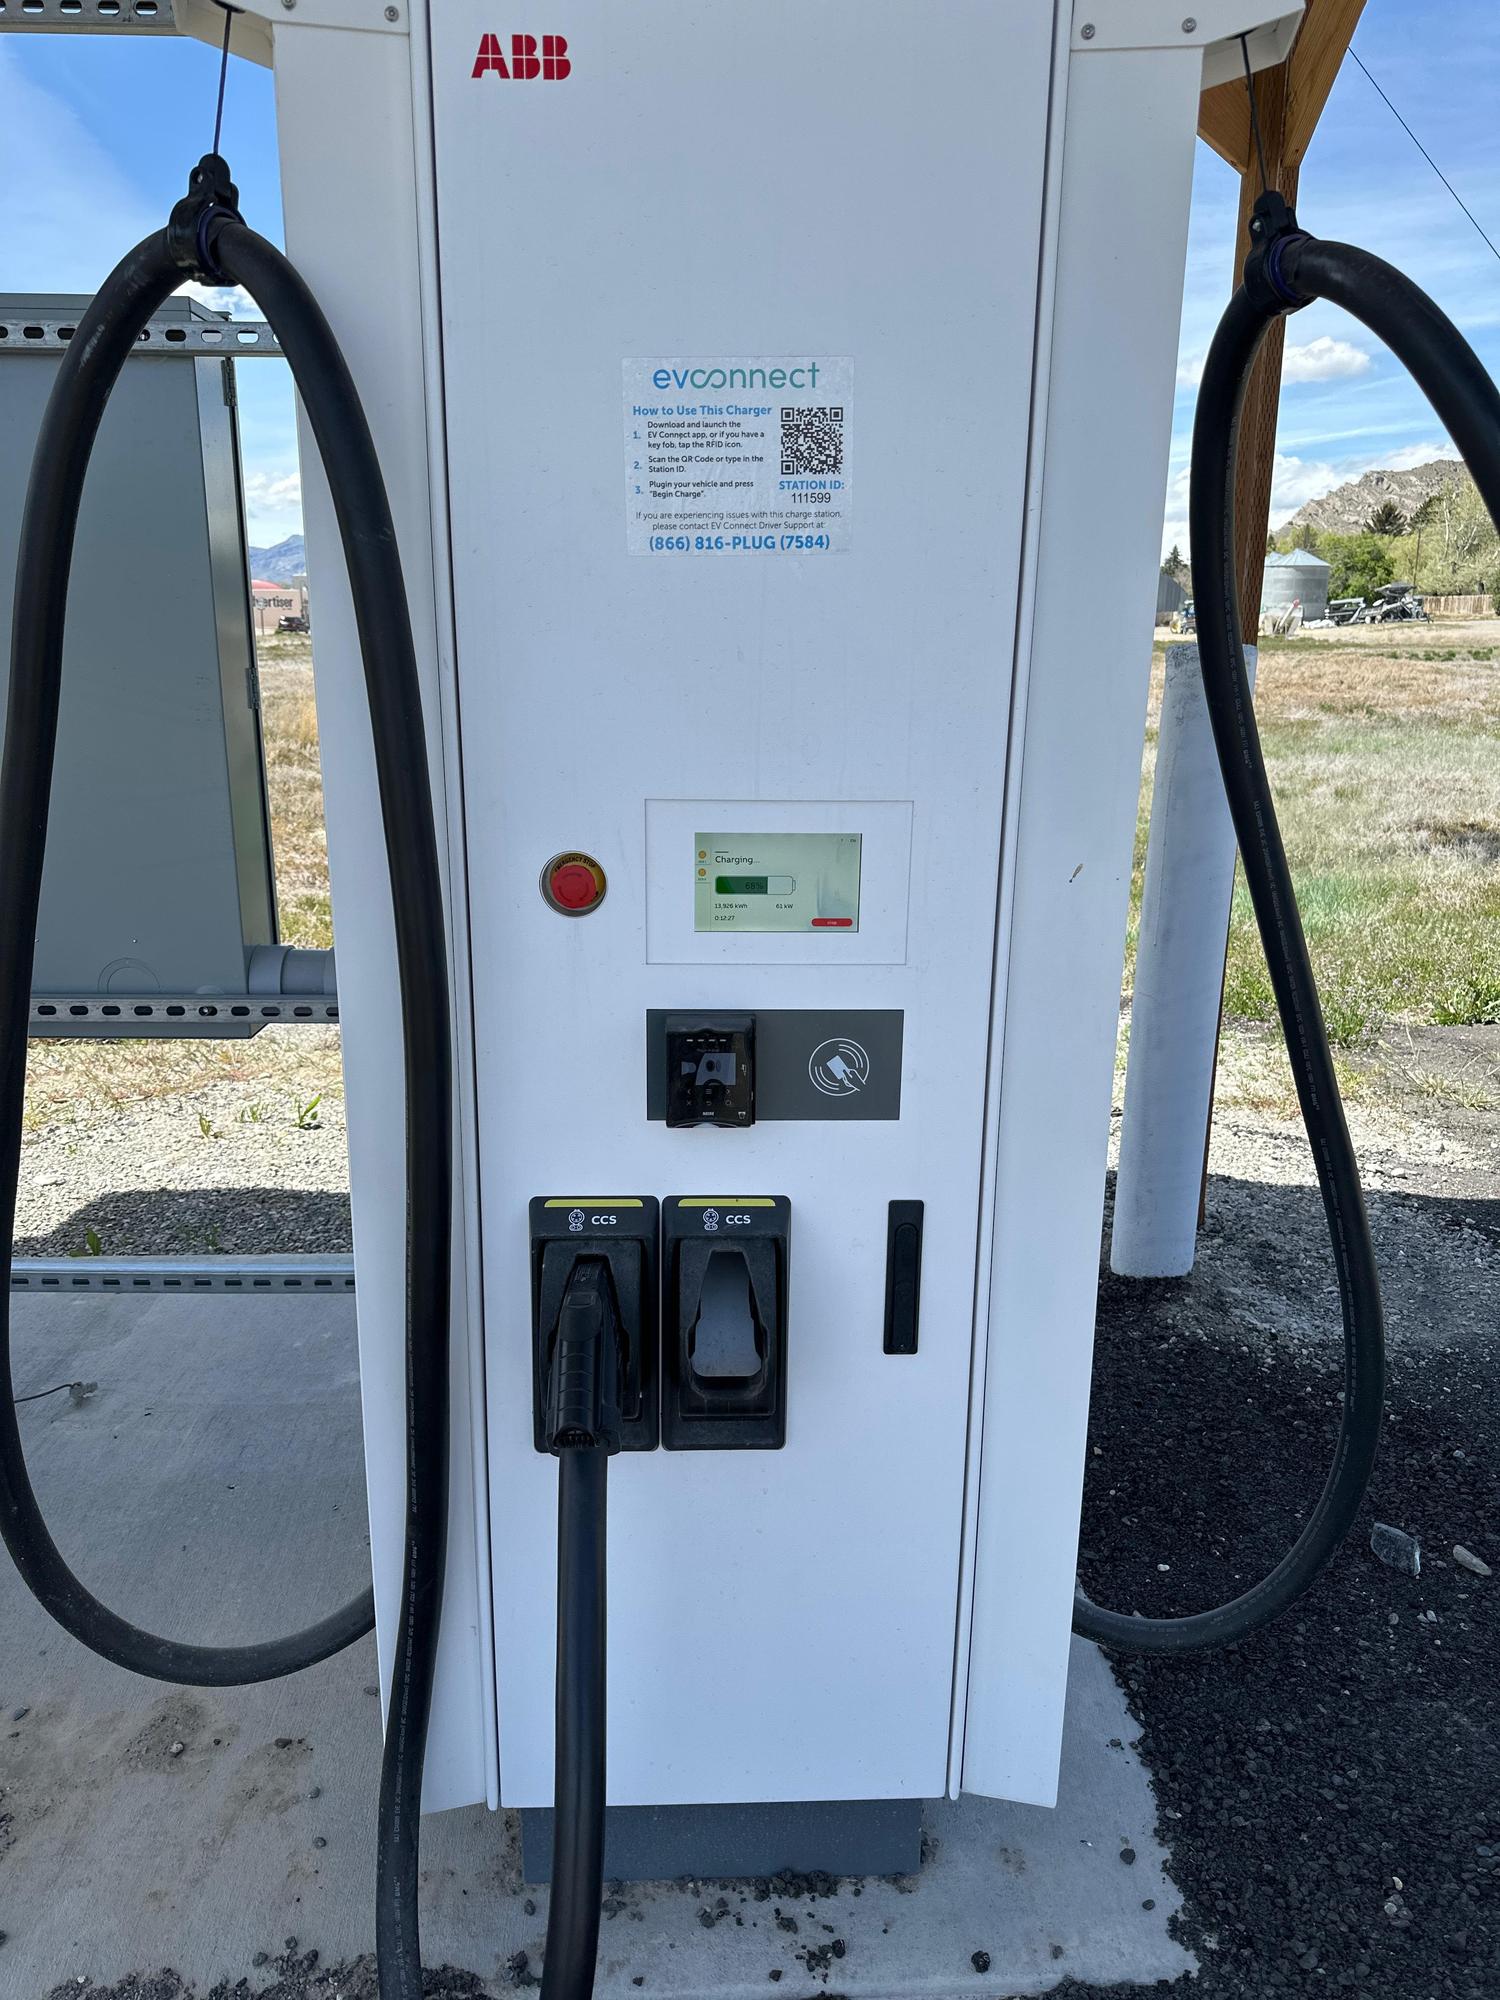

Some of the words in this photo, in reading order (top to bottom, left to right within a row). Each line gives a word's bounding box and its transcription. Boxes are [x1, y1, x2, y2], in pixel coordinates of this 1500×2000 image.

[471, 33, 571, 80] ABB
[653, 362, 820, 389] evconnect
[633, 405, 659, 416] How
[662, 407, 673, 416] to
[677, 405, 696, 416] Use
[700, 405, 723, 415] This
[726, 405, 772, 417] Charger
[633, 431, 641, 439] 1.
[692, 432, 707, 440] app,
[726, 432, 740, 440] you
[648, 441, 661, 450] key
[662, 441, 676, 449] fob,
[678, 442, 690, 450] tap
[725, 456, 741, 464] type
[634, 461, 642, 469] 2.
[649, 481, 672, 489] Plugin
[779, 481, 826, 490] STATION
[829, 481, 845, 490] ID:
[635, 486, 643, 494] 3.
[791, 493, 831, 503] 111599
[643, 512, 658, 520] you
[674, 512, 724, 520] experiencing
[785, 511, 812, 520] charge
[814, 511, 842, 519] station,
[653, 522, 677, 531] please
[784, 521, 814, 530] Support
[650, 535, 690, 550] (866)
[695, 535, 776, 550] 816-PLUG
[780, 535, 830, 550] (7584)
[591, 1216, 617, 1225] CCS
[725, 1215, 751, 1224] CCS
